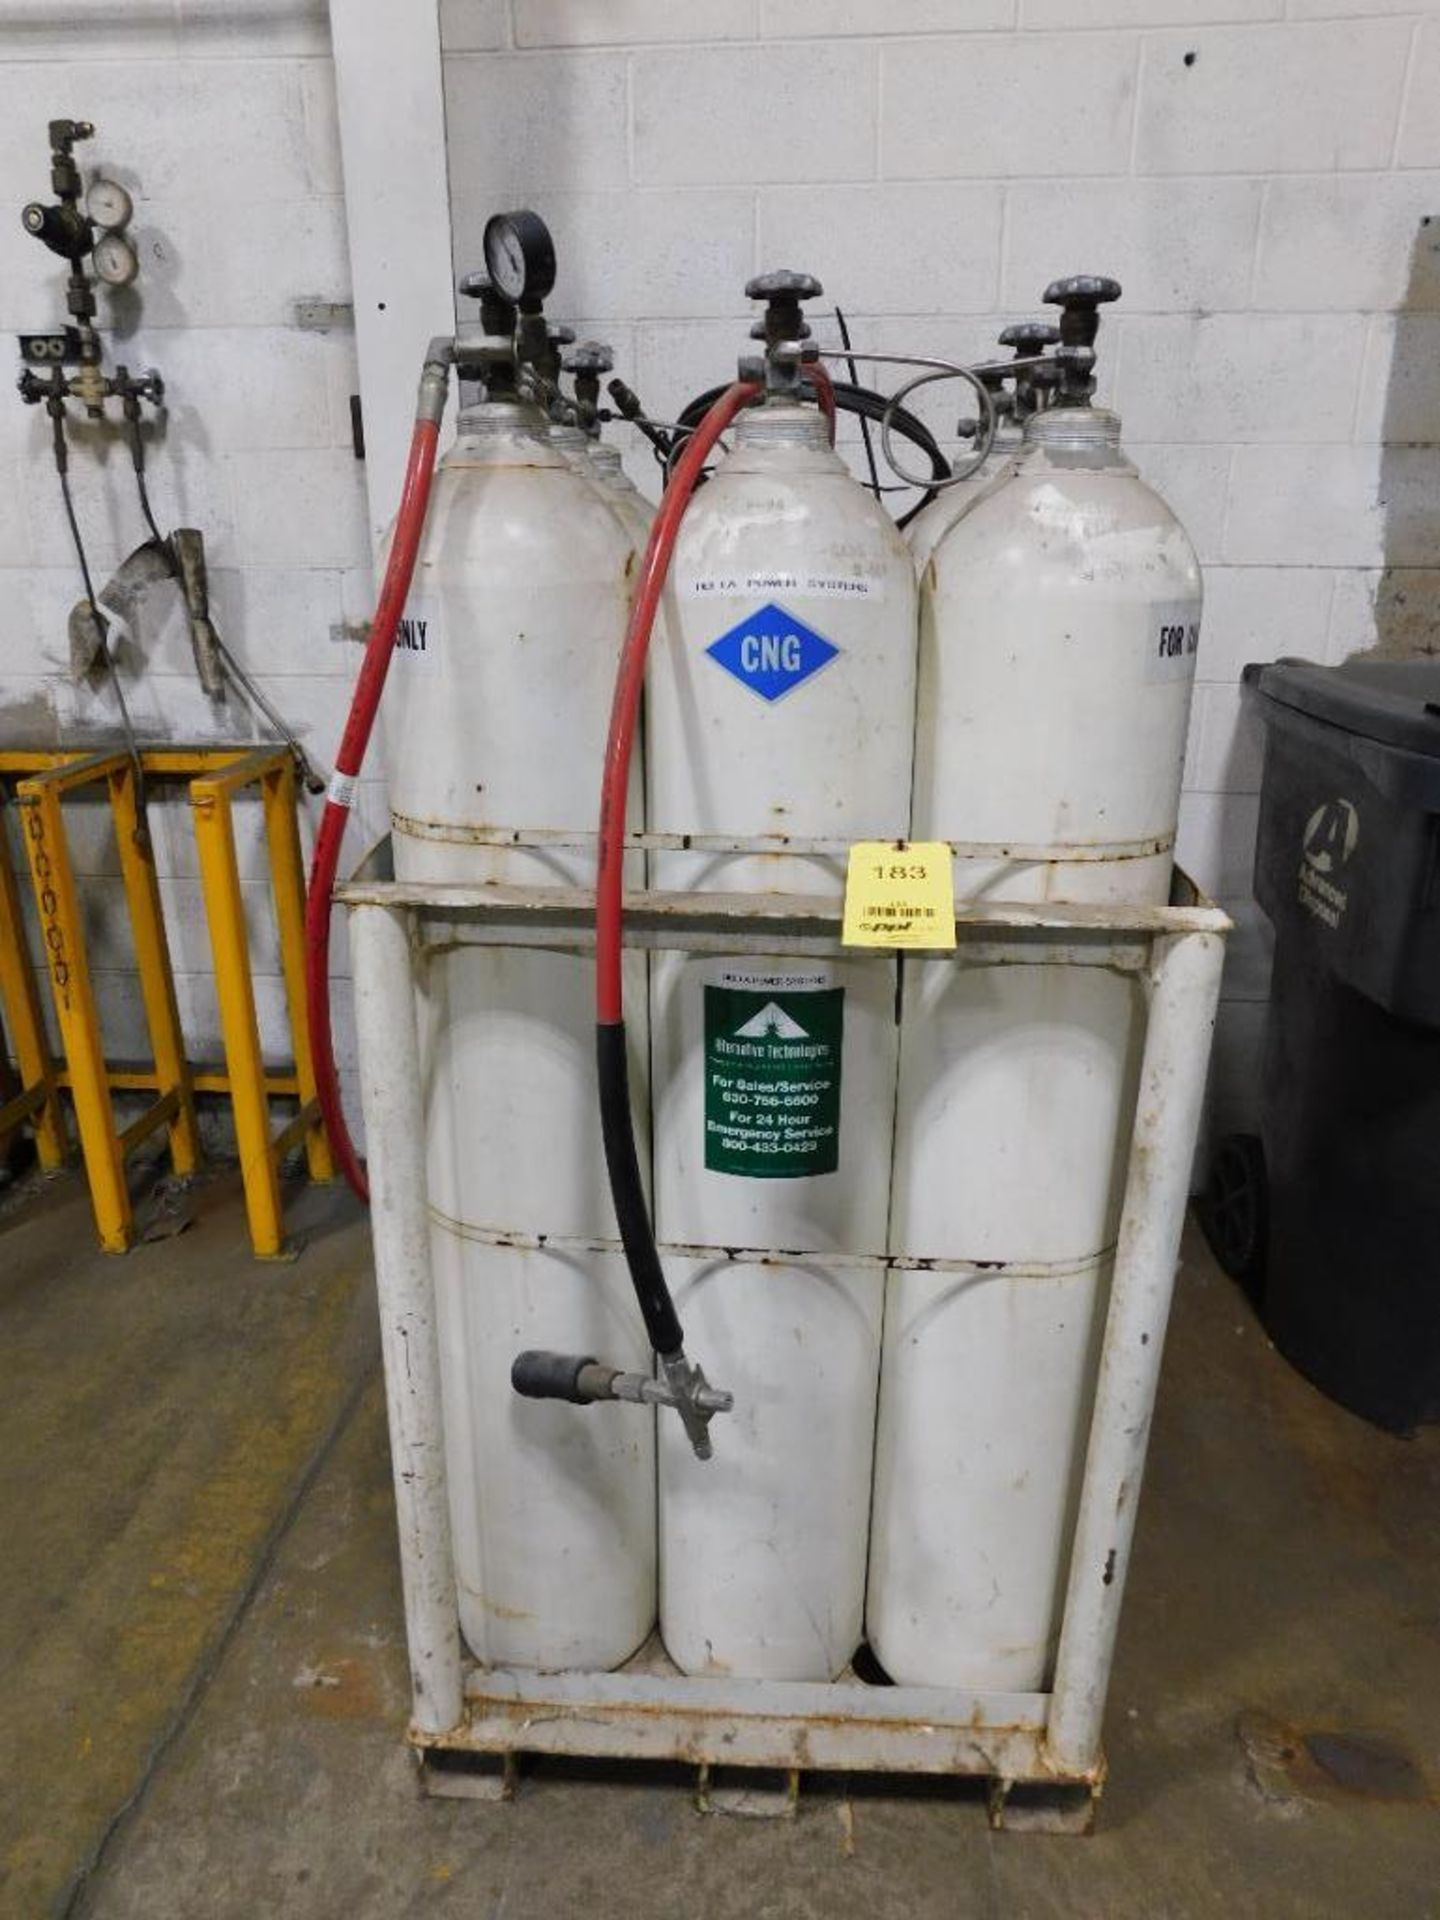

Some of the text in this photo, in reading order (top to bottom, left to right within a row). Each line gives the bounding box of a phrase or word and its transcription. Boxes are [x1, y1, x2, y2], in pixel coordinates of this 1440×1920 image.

[1159, 624, 1185, 658] FOR
[741, 633, 801, 673] CNG
[872, 865, 927, 880] 183
[712, 1074, 831, 1093] For Sales/Service
[729, 1110, 812, 1126] For 24 Hour
[707, 1119, 834, 1142] Emergency Service
